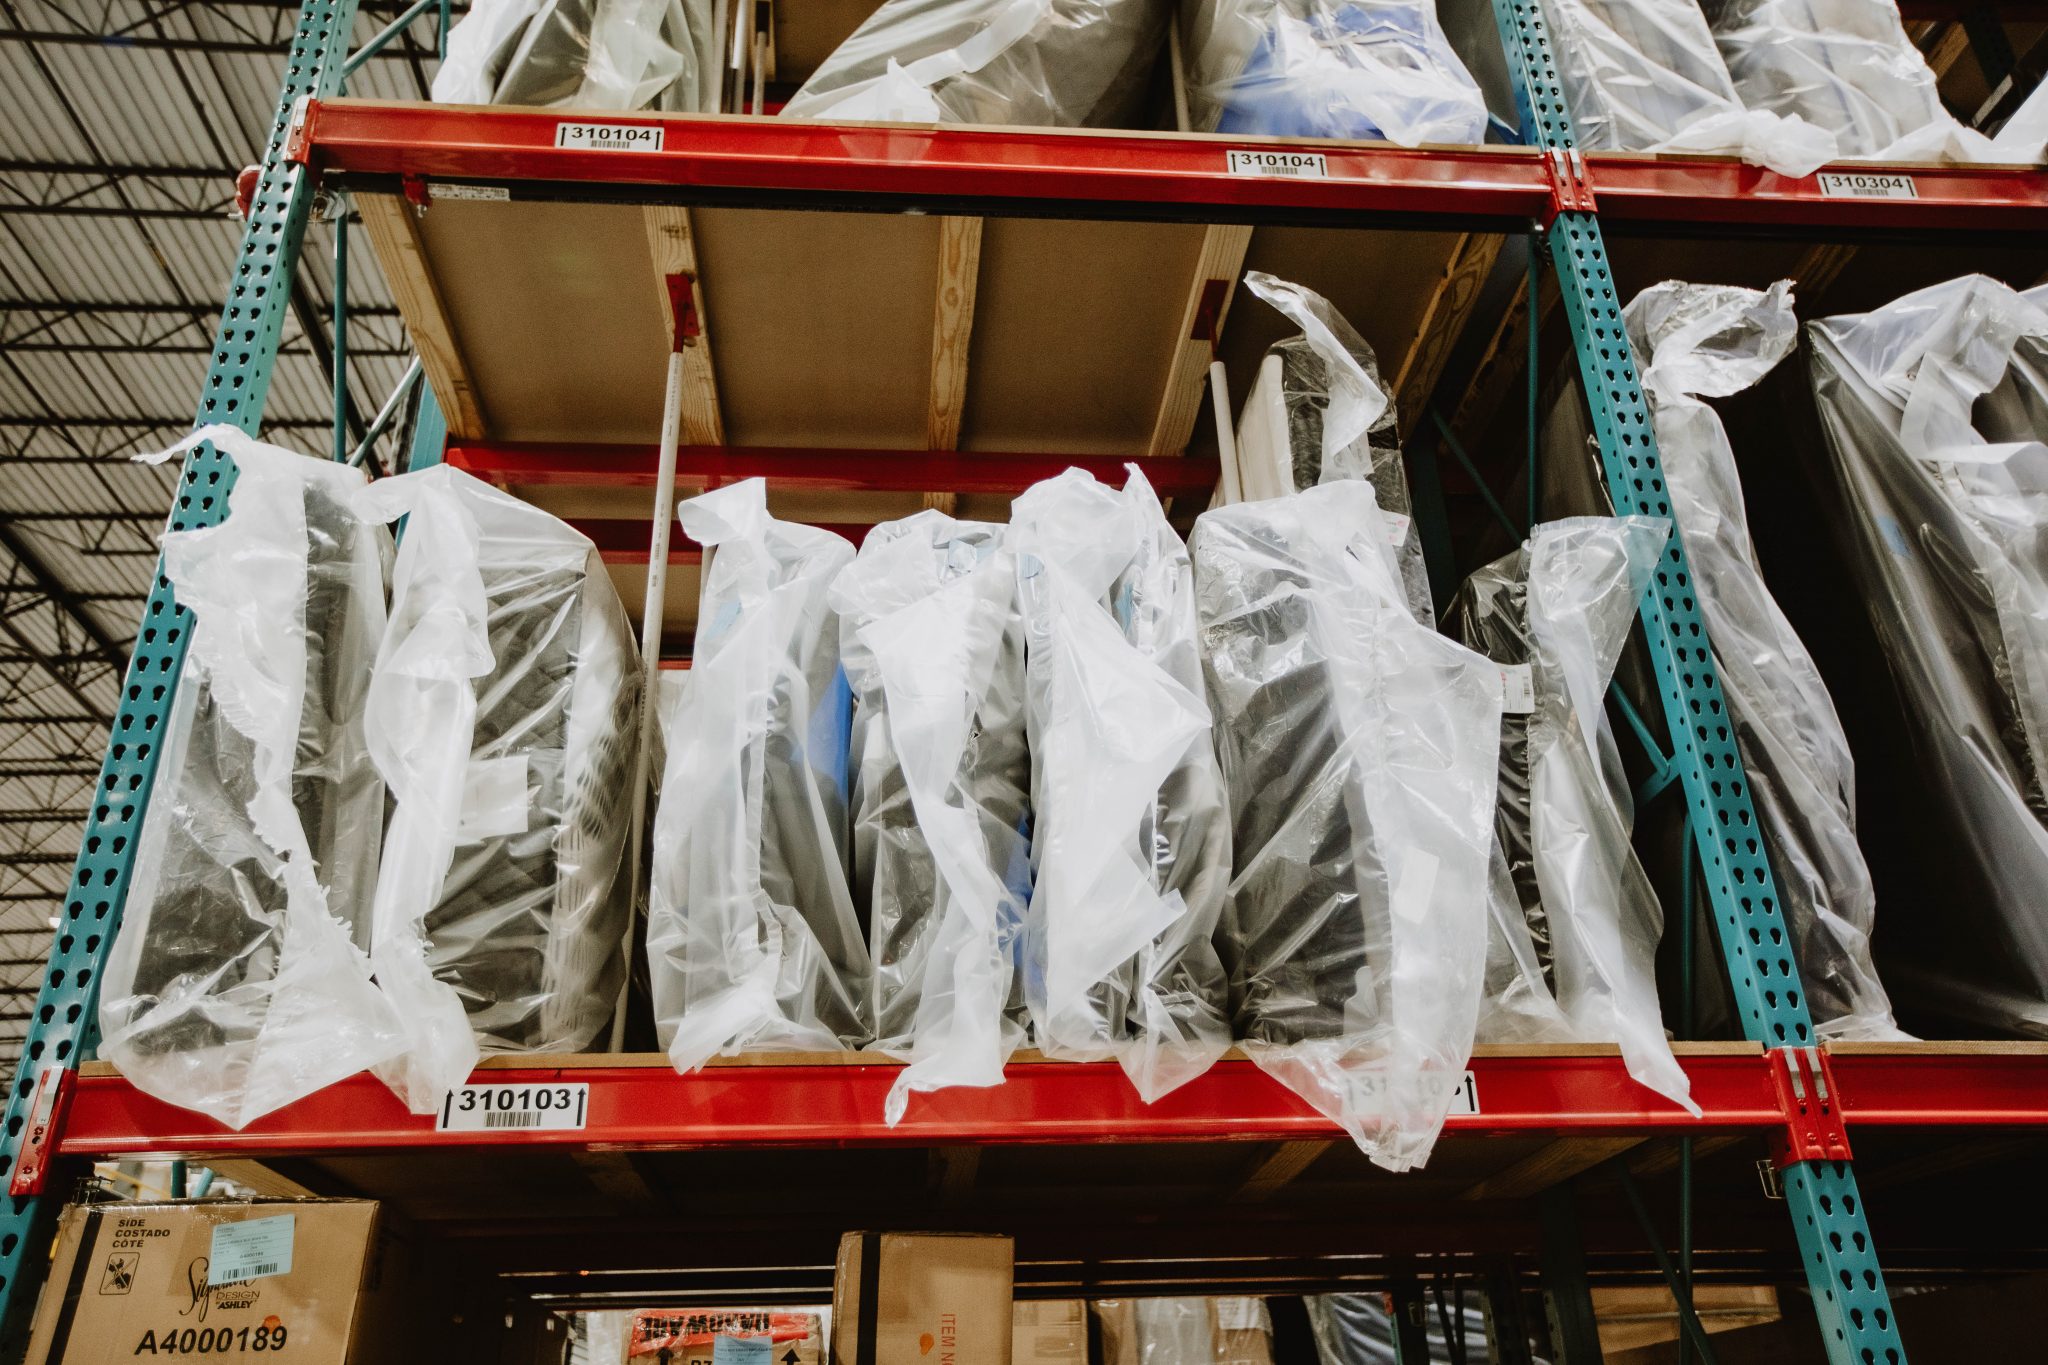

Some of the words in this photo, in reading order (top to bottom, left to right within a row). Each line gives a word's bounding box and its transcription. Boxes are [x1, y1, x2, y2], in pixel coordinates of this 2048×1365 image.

[571, 126, 651, 141] 310104
[1241, 153, 1315, 167] 310104
[1831, 176, 1903, 189] 310304
[458, 1088, 571, 1111] 310103
[118, 1219, 146, 1227] SIDE
[115, 1229, 170, 1238] COSTADO
[216, 1291, 260, 1299] DESIGN
[217, 1301, 253, 1309] ASHLEY
[941, 1313, 956, 1347] ITEM
[134, 1325, 288, 1355] A4000189
[941, 1352, 956, 1365] N
